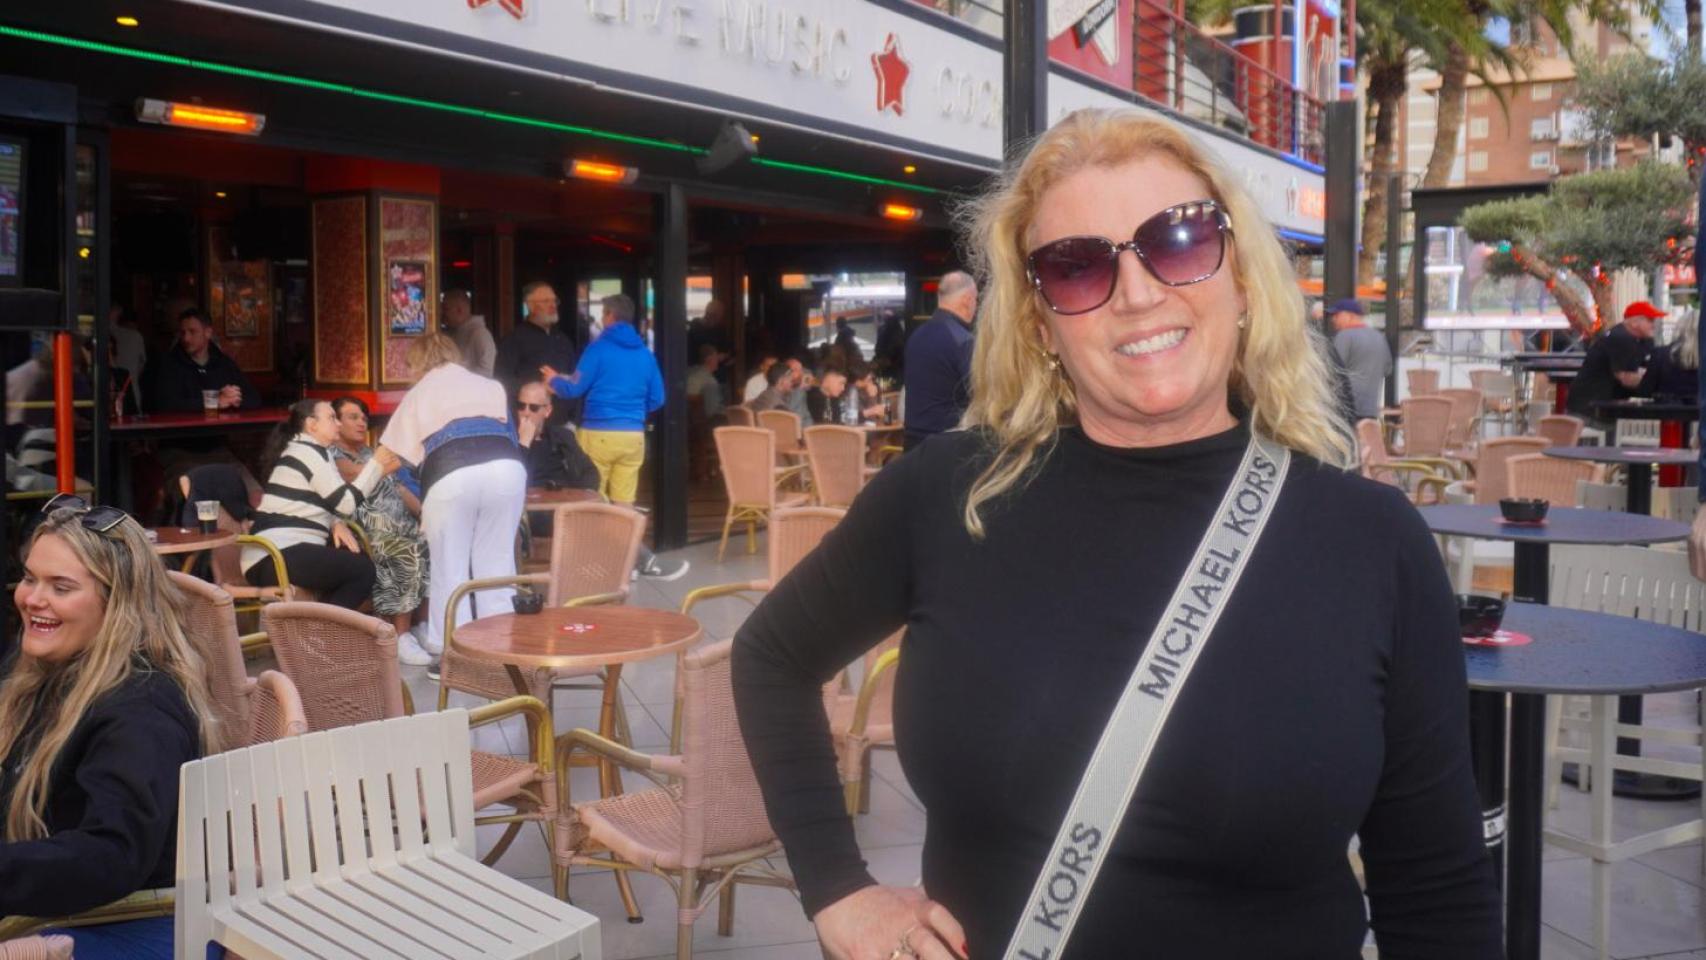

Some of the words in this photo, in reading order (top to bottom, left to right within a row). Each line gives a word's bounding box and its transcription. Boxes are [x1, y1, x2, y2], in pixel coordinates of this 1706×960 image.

[718, 0, 853, 85] MUSIC
[1138, 548, 1241, 700] MICHAEL
[1223, 456, 1277, 537] KORS
[1033, 822, 1102, 932] KORS
